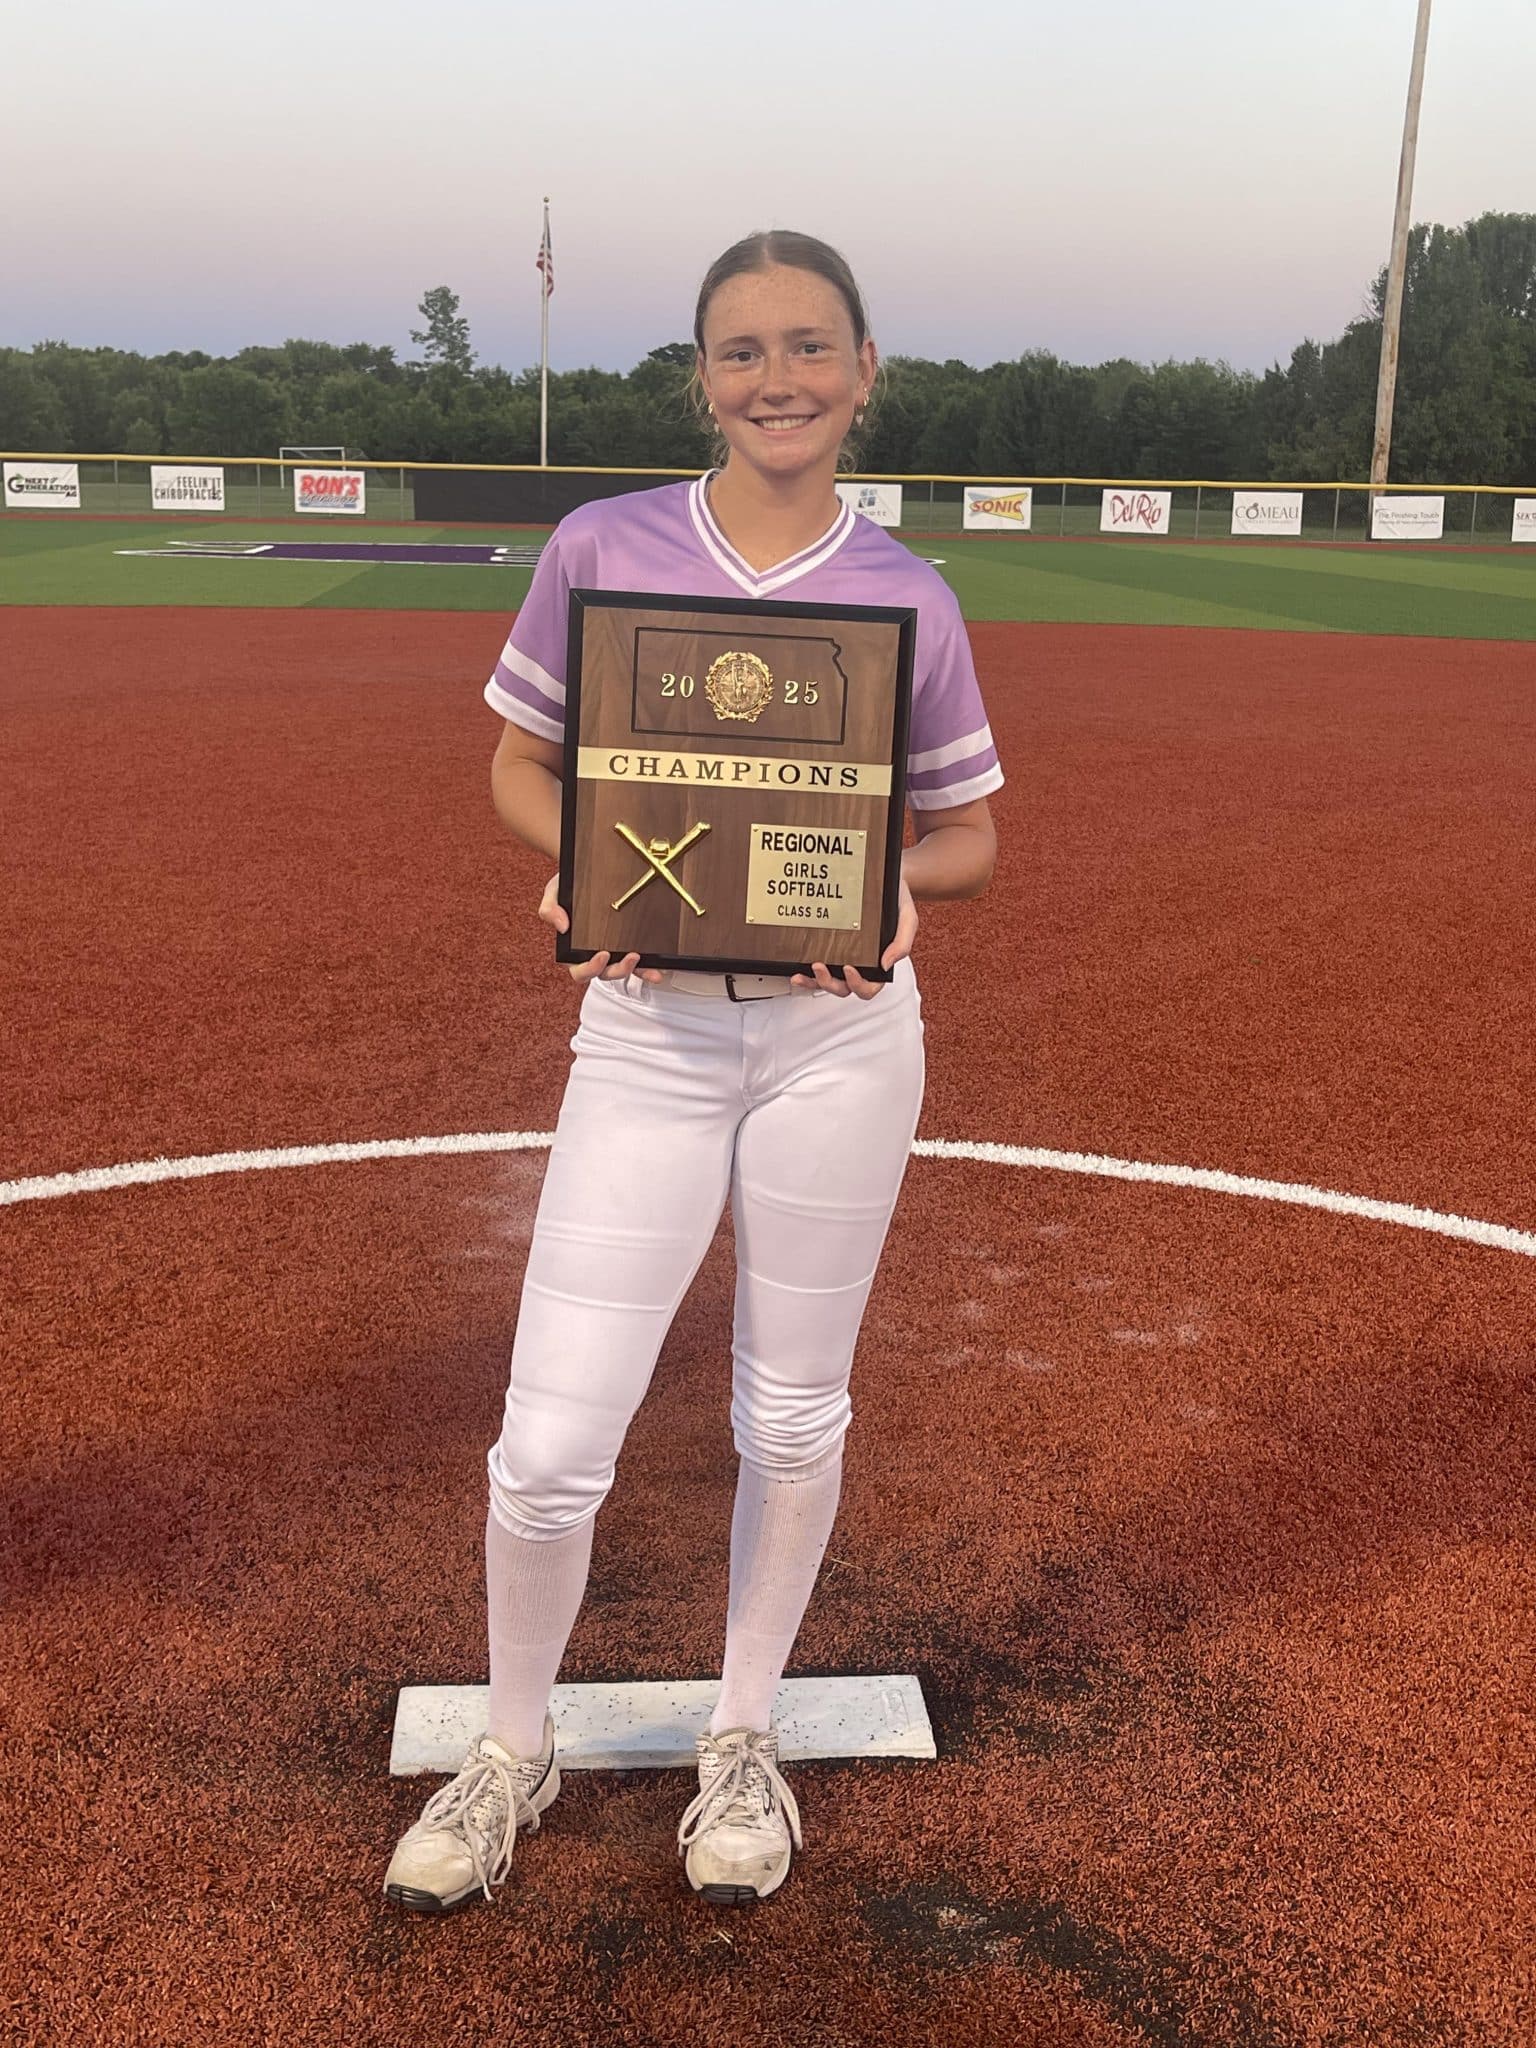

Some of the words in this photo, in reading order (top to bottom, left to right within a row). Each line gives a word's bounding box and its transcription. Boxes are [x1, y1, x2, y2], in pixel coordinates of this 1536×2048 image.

[301, 474, 361, 496] RON'S
[154, 488, 222, 501] CHIROPRACTIC
[971, 500, 1023, 513] SONIC
[1110, 494, 1135, 525] Del
[1235, 503, 1299, 519] COMEAU
[1420, 511, 1440, 519] Touch
[660, 673, 695, 698] 20
[783, 680, 819, 705] 25
[608, 754, 858, 787] CHAMPIONS
[761, 831, 853, 856] REGIONAL
[783, 862, 829, 879] GIRLS
[766, 879, 843, 899] SOFTBALL
[777, 904, 812, 918] CLASS
[816, 907, 829, 919] 5A
